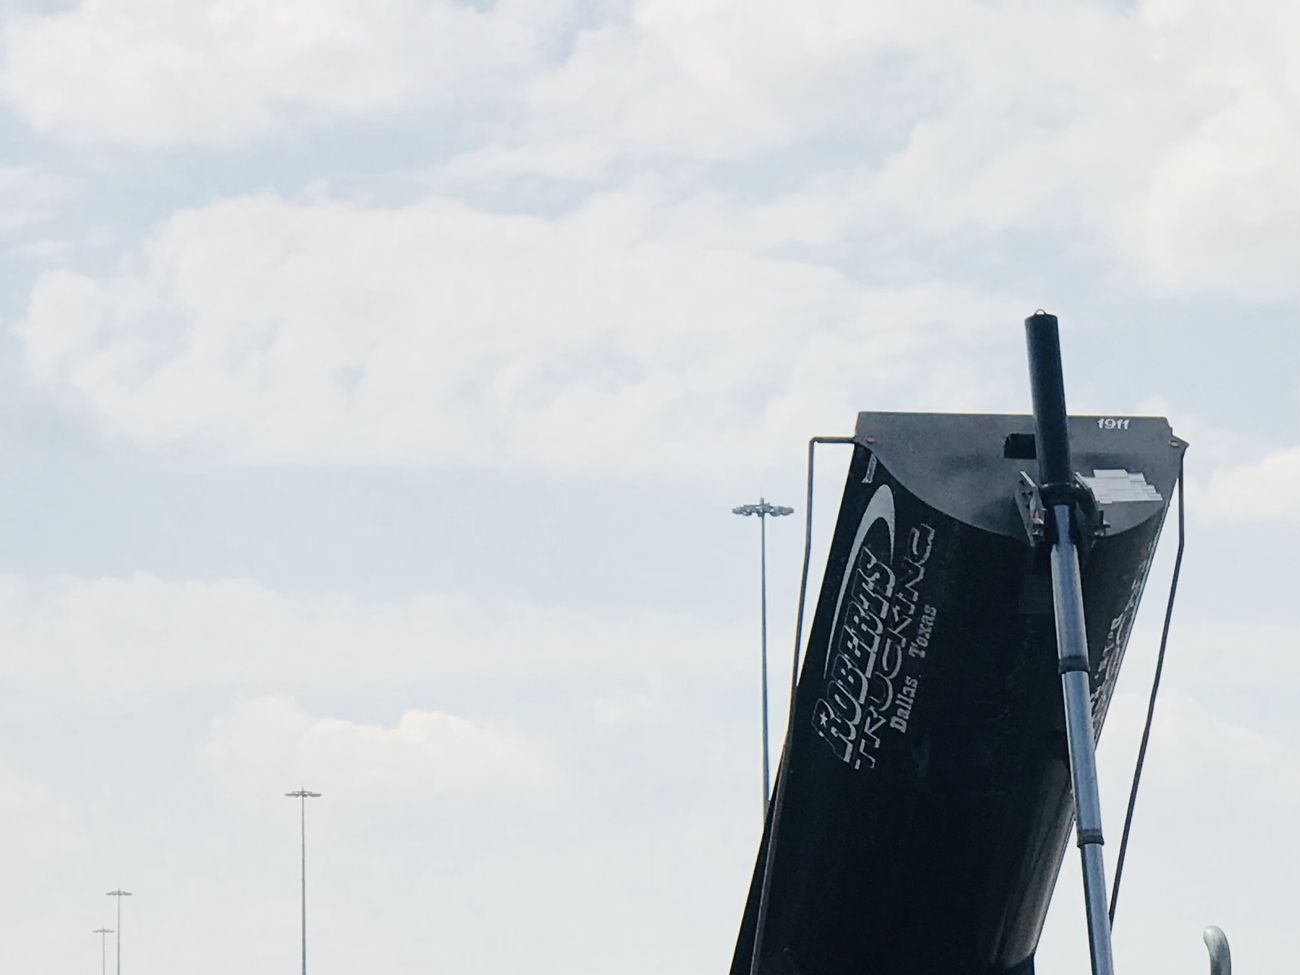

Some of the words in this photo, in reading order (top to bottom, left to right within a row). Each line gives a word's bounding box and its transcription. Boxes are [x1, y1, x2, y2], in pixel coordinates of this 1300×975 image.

[811, 546, 896, 763] ROBERTS
[854, 522, 936, 769] TRUCKING
[908, 604, 937, 658] Texas
